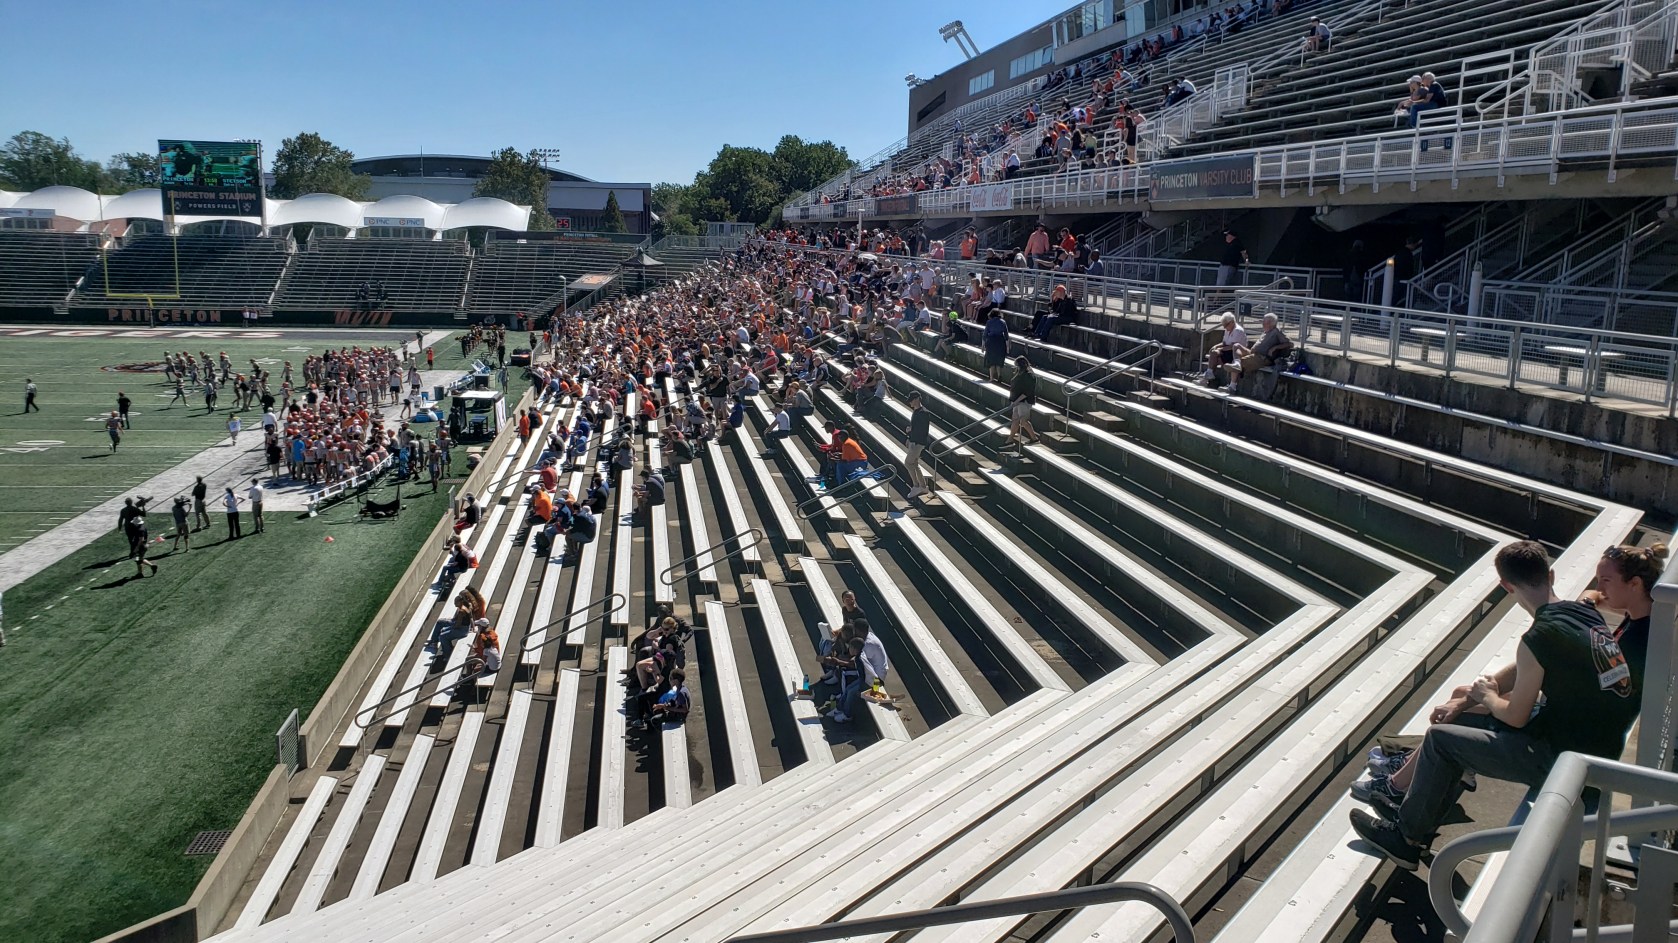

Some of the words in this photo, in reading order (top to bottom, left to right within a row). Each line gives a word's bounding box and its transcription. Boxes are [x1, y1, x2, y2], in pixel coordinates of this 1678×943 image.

[1160, 172, 1198, 189] PRINCETON
[1200, 170, 1228, 186] VARSITY
[1230, 168, 1252, 184] CLUB
[167, 190, 216, 199] PRINCETON
[218, 192, 256, 200] STADIUM
[558, 220, 568, 228] 25
